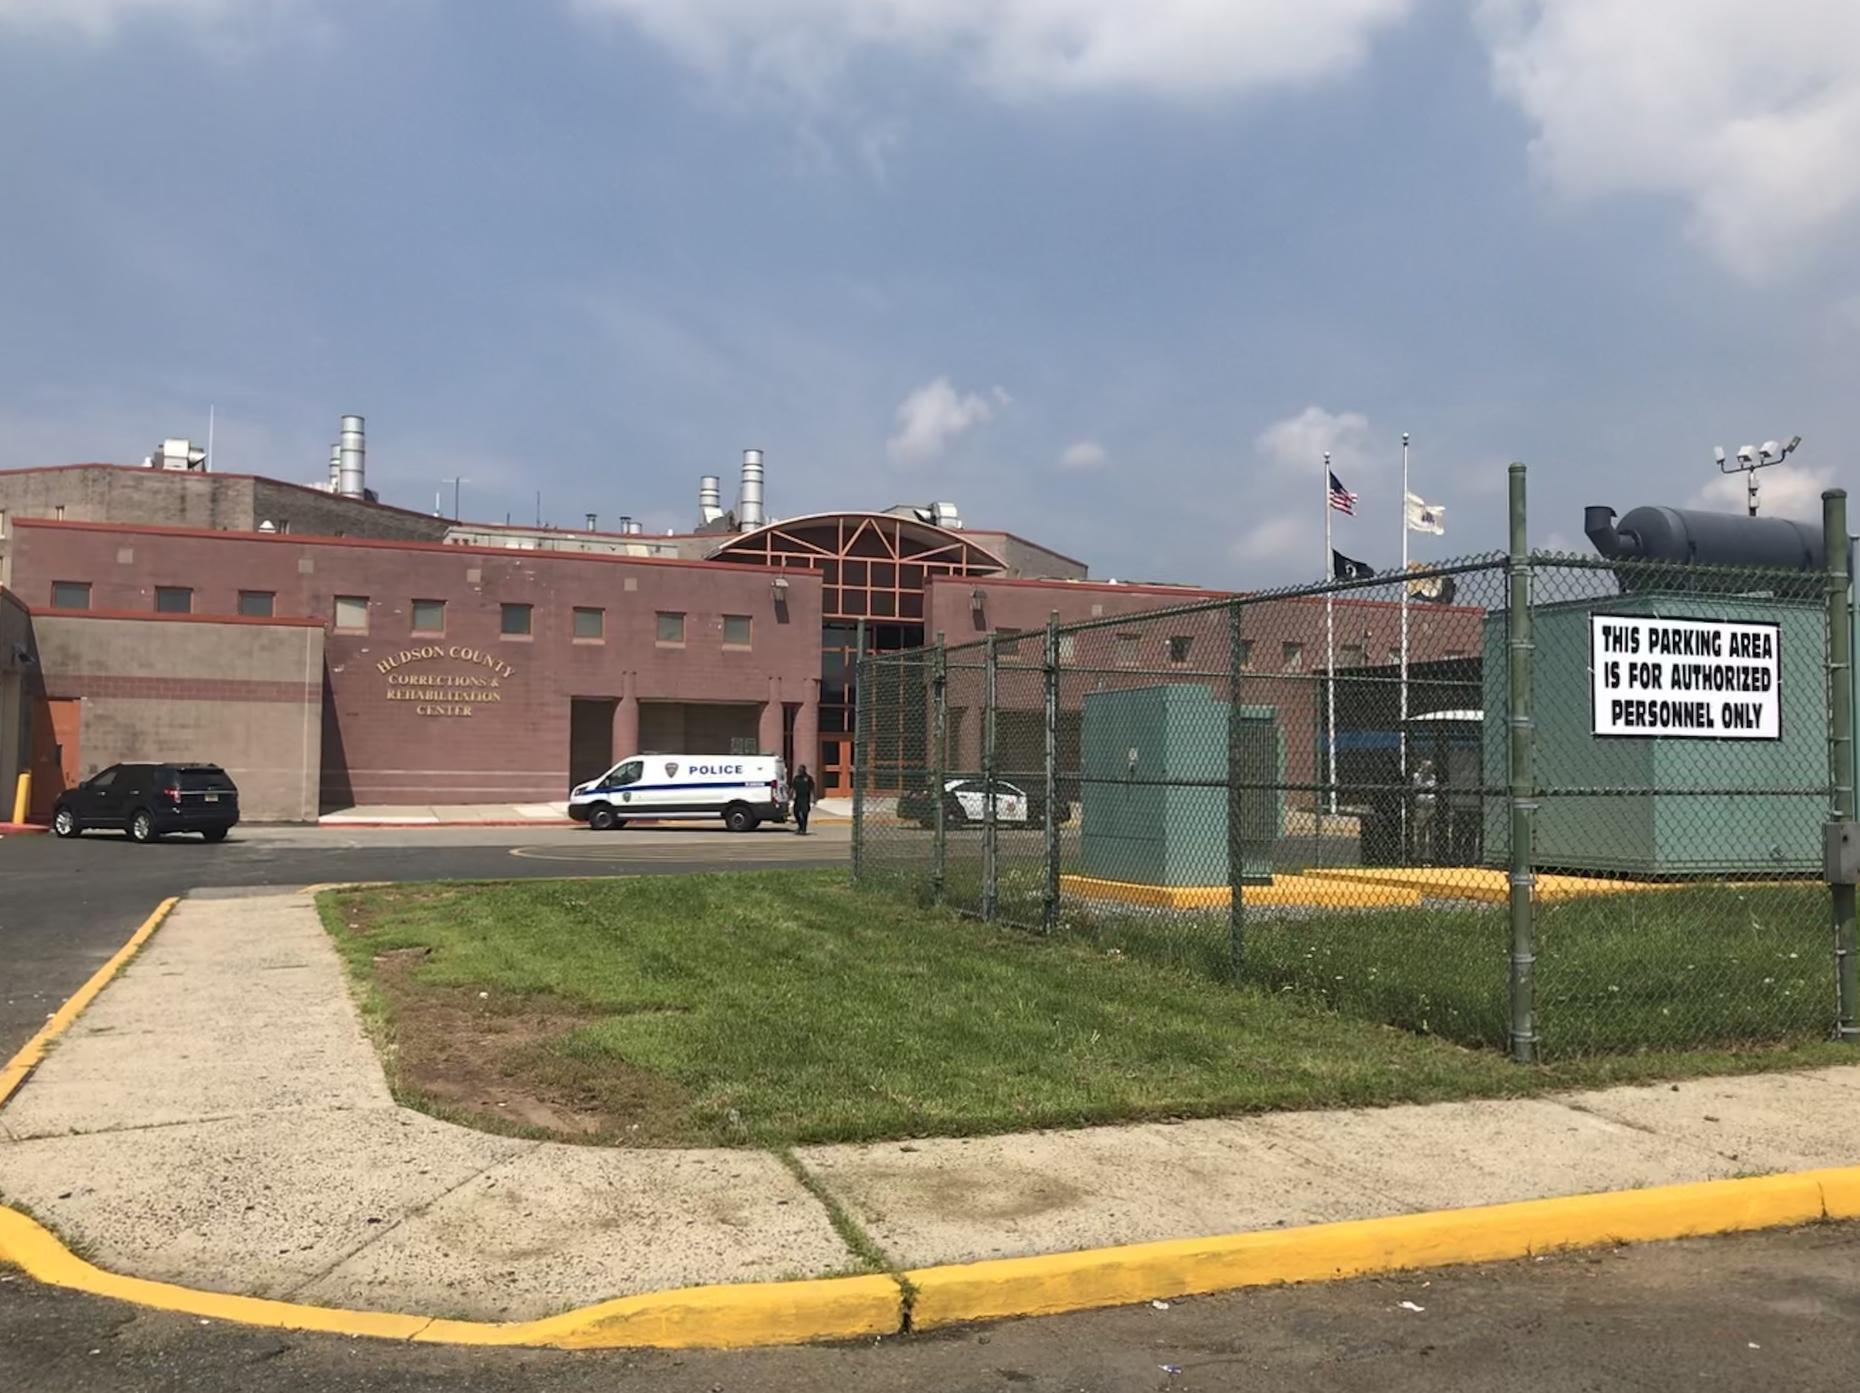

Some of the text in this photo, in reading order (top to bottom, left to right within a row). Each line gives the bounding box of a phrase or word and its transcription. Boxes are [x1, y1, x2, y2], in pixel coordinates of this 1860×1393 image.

[1602, 625, 1772, 659] THIS PARKING AREA
[376, 646, 516, 678] HUDSON COUNTY
[388, 673, 500, 688] CORRECTIONS &
[1604, 661, 1771, 692] IS FOR AUTHORIZED
[386, 688, 501, 702] REHABILITATION
[416, 703, 472, 717] CENTER
[1611, 700, 1763, 729] PERSONNEL ONLY
[688, 764, 744, 775] POLICE
